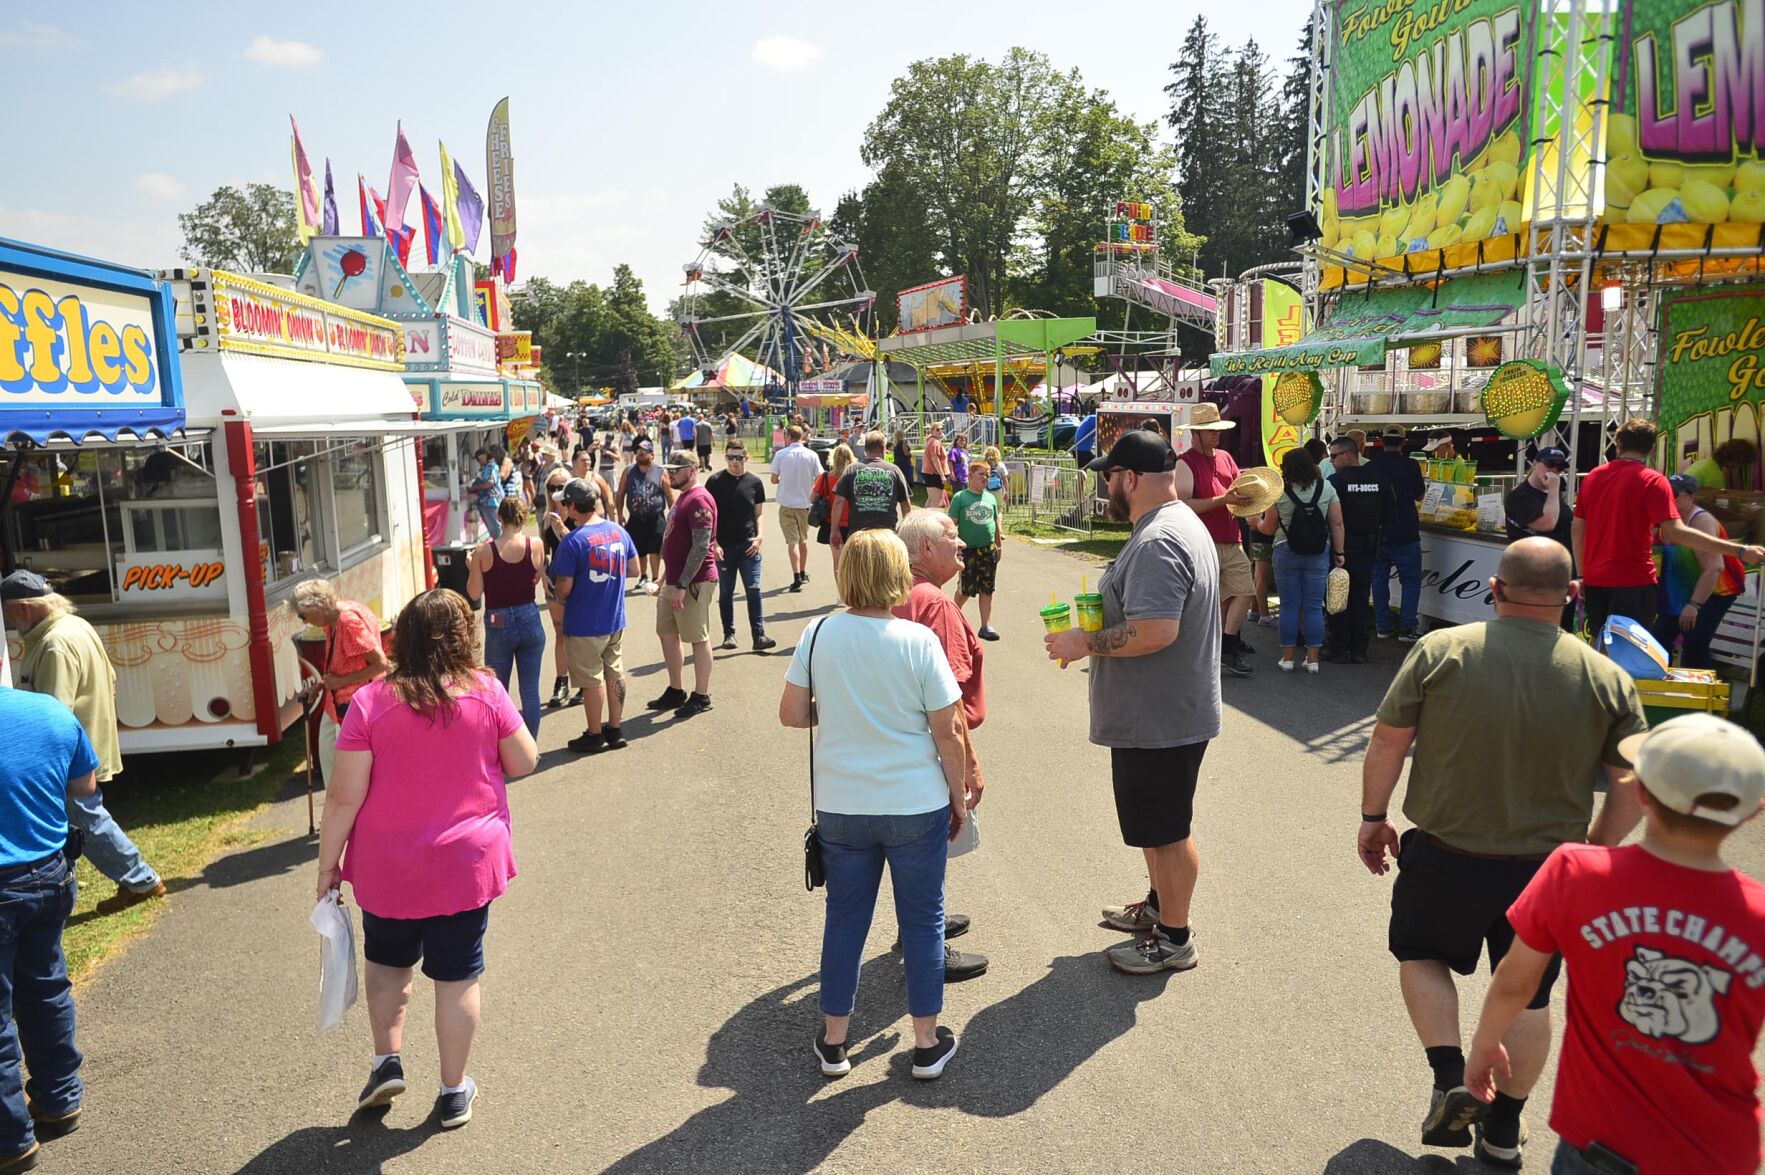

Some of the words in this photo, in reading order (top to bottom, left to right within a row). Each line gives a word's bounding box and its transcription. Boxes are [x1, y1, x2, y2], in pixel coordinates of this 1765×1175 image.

[1335, 8, 1521, 218] LEMONADE
[490, 117, 506, 219] CHEESE
[499, 123, 513, 209] FRIES
[1116, 202, 1152, 220] FUN
[1111, 223, 1155, 241] SLIDE
[1225, 359, 1246, 372] We
[1249, 355, 1287, 371] Refill
[1289, 351, 1324, 367] Any
[1328, 348, 1357, 363] Cup
[442, 388, 461, 407] Cold
[122, 561, 225, 591] PICK-UP
[1580, 906, 1661, 949] STATE
[1664, 909, 1765, 989] CHAMPS
